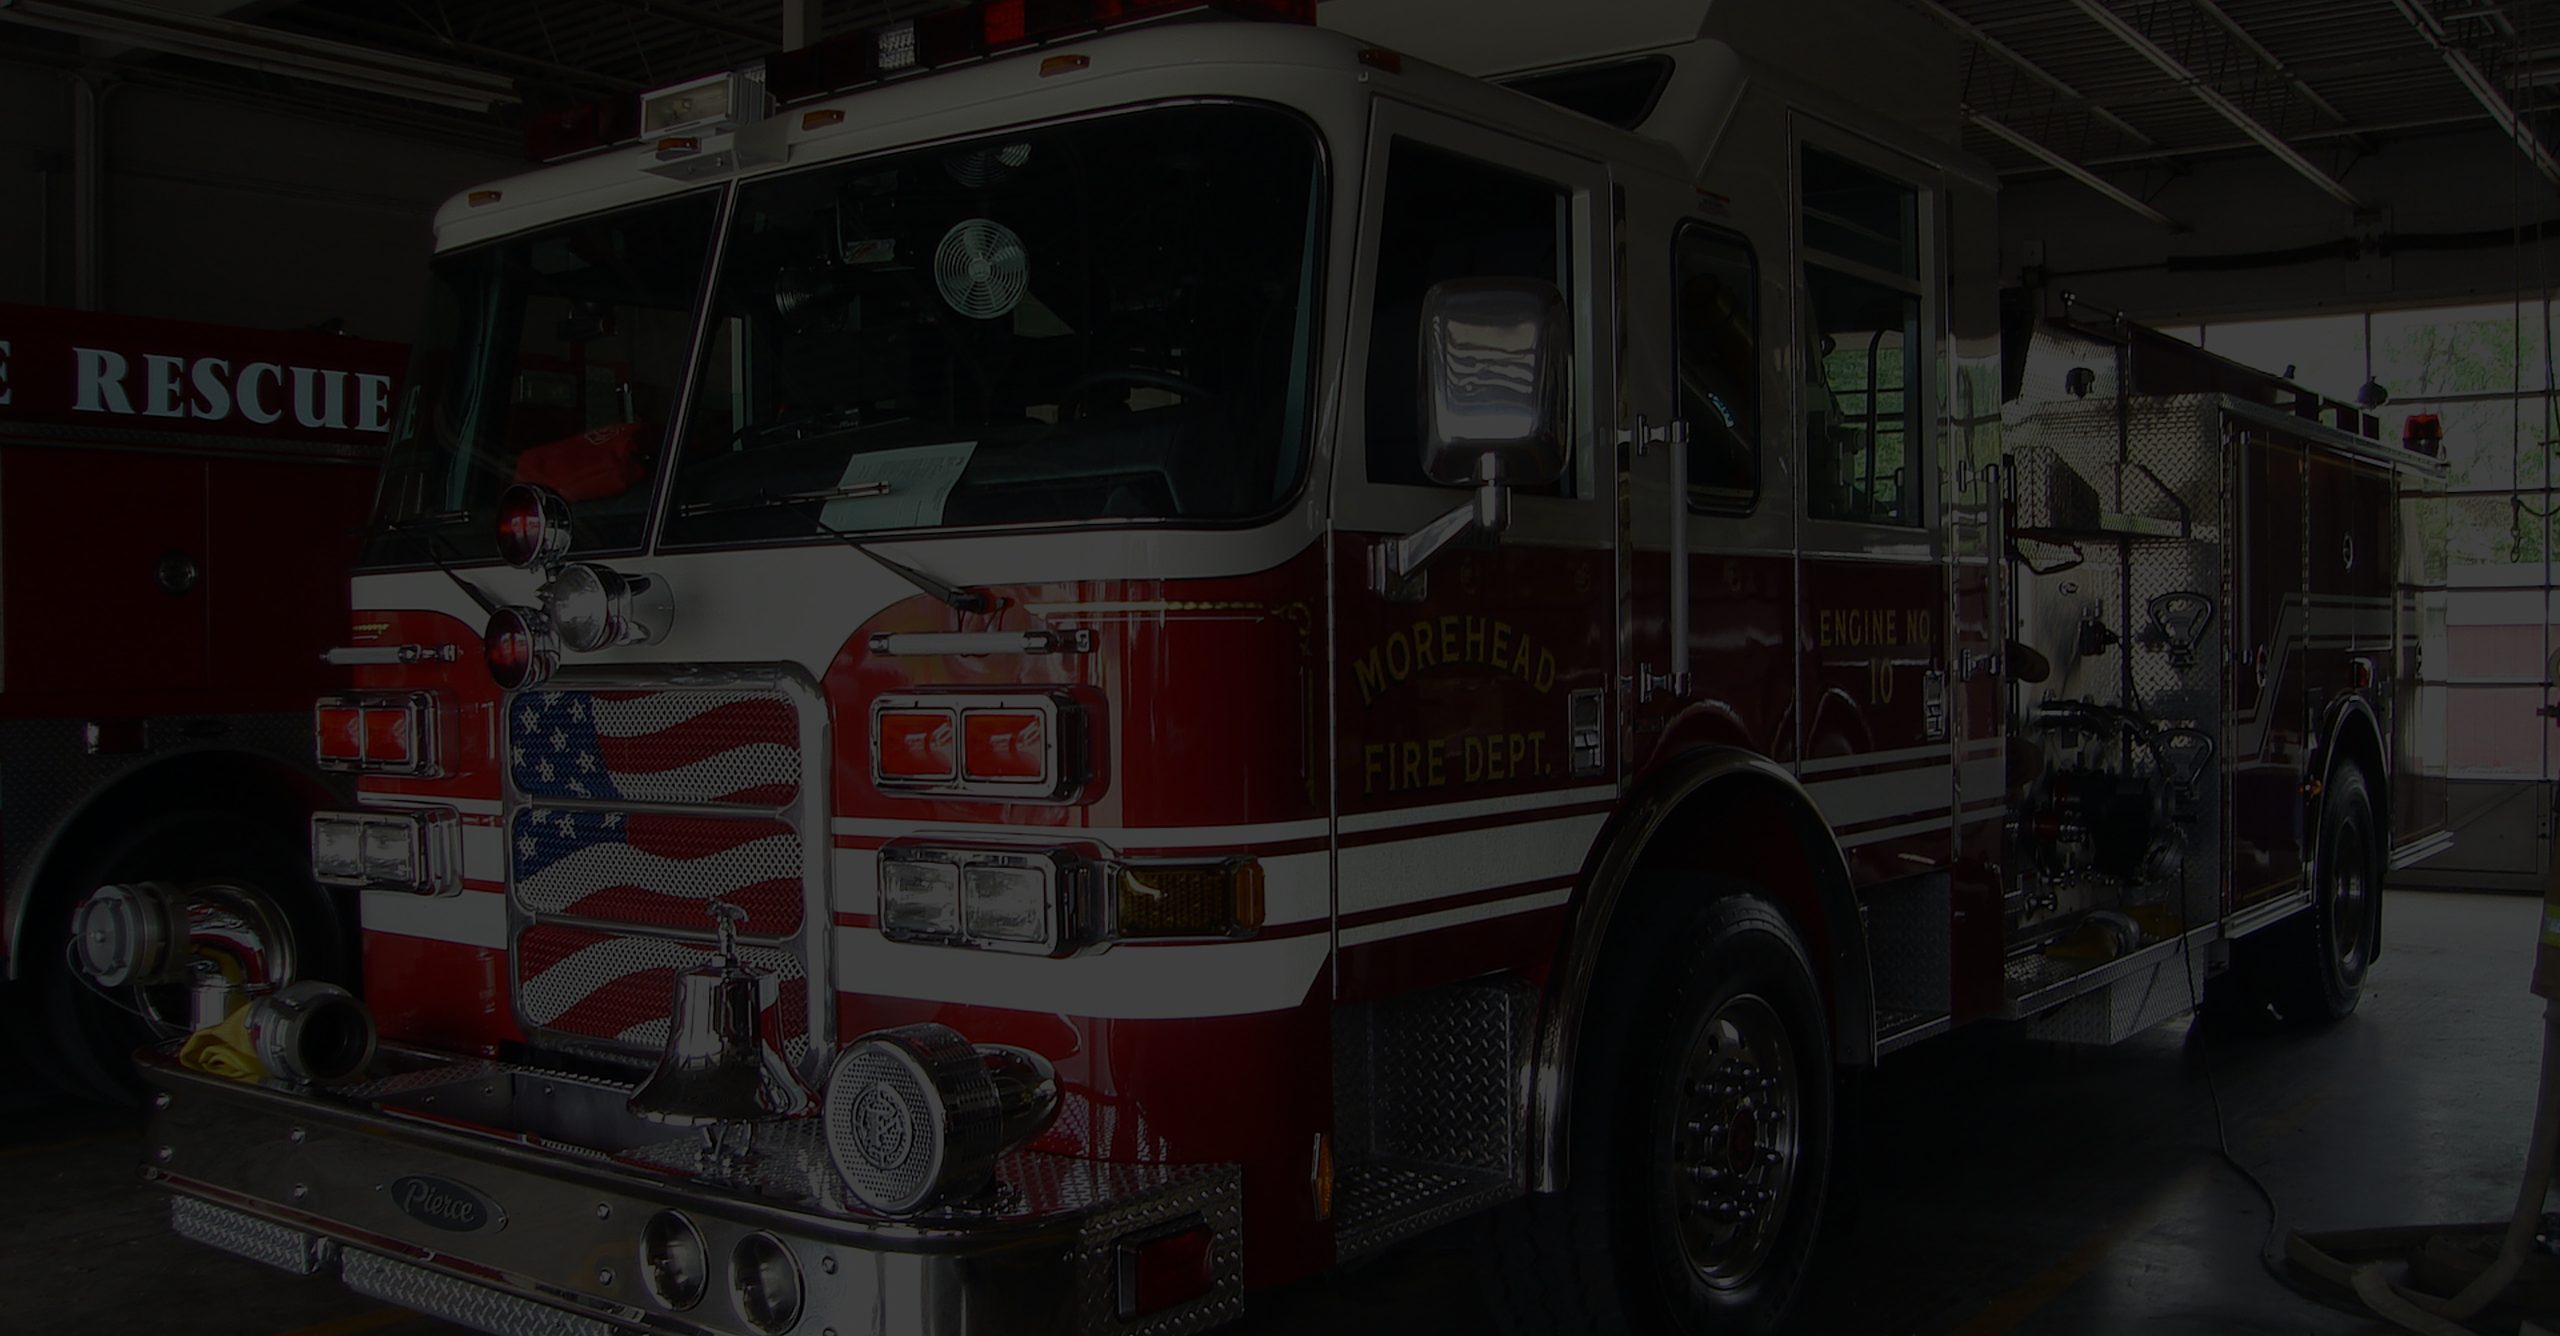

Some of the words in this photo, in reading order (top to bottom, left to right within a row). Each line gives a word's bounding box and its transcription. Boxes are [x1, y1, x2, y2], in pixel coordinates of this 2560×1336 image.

[72, 346, 393, 434] RESCUE
[1820, 608, 1897, 647] ENGINE
[1905, 608, 1937, 644] NO.
[1352, 614, 1557, 708] MOREHEAD
[1870, 657, 1894, 705] 10
[1364, 737, 1447, 793] FIRE
[1463, 730, 1552, 784] DEPT.
[403, 1178, 475, 1223] Pierce
